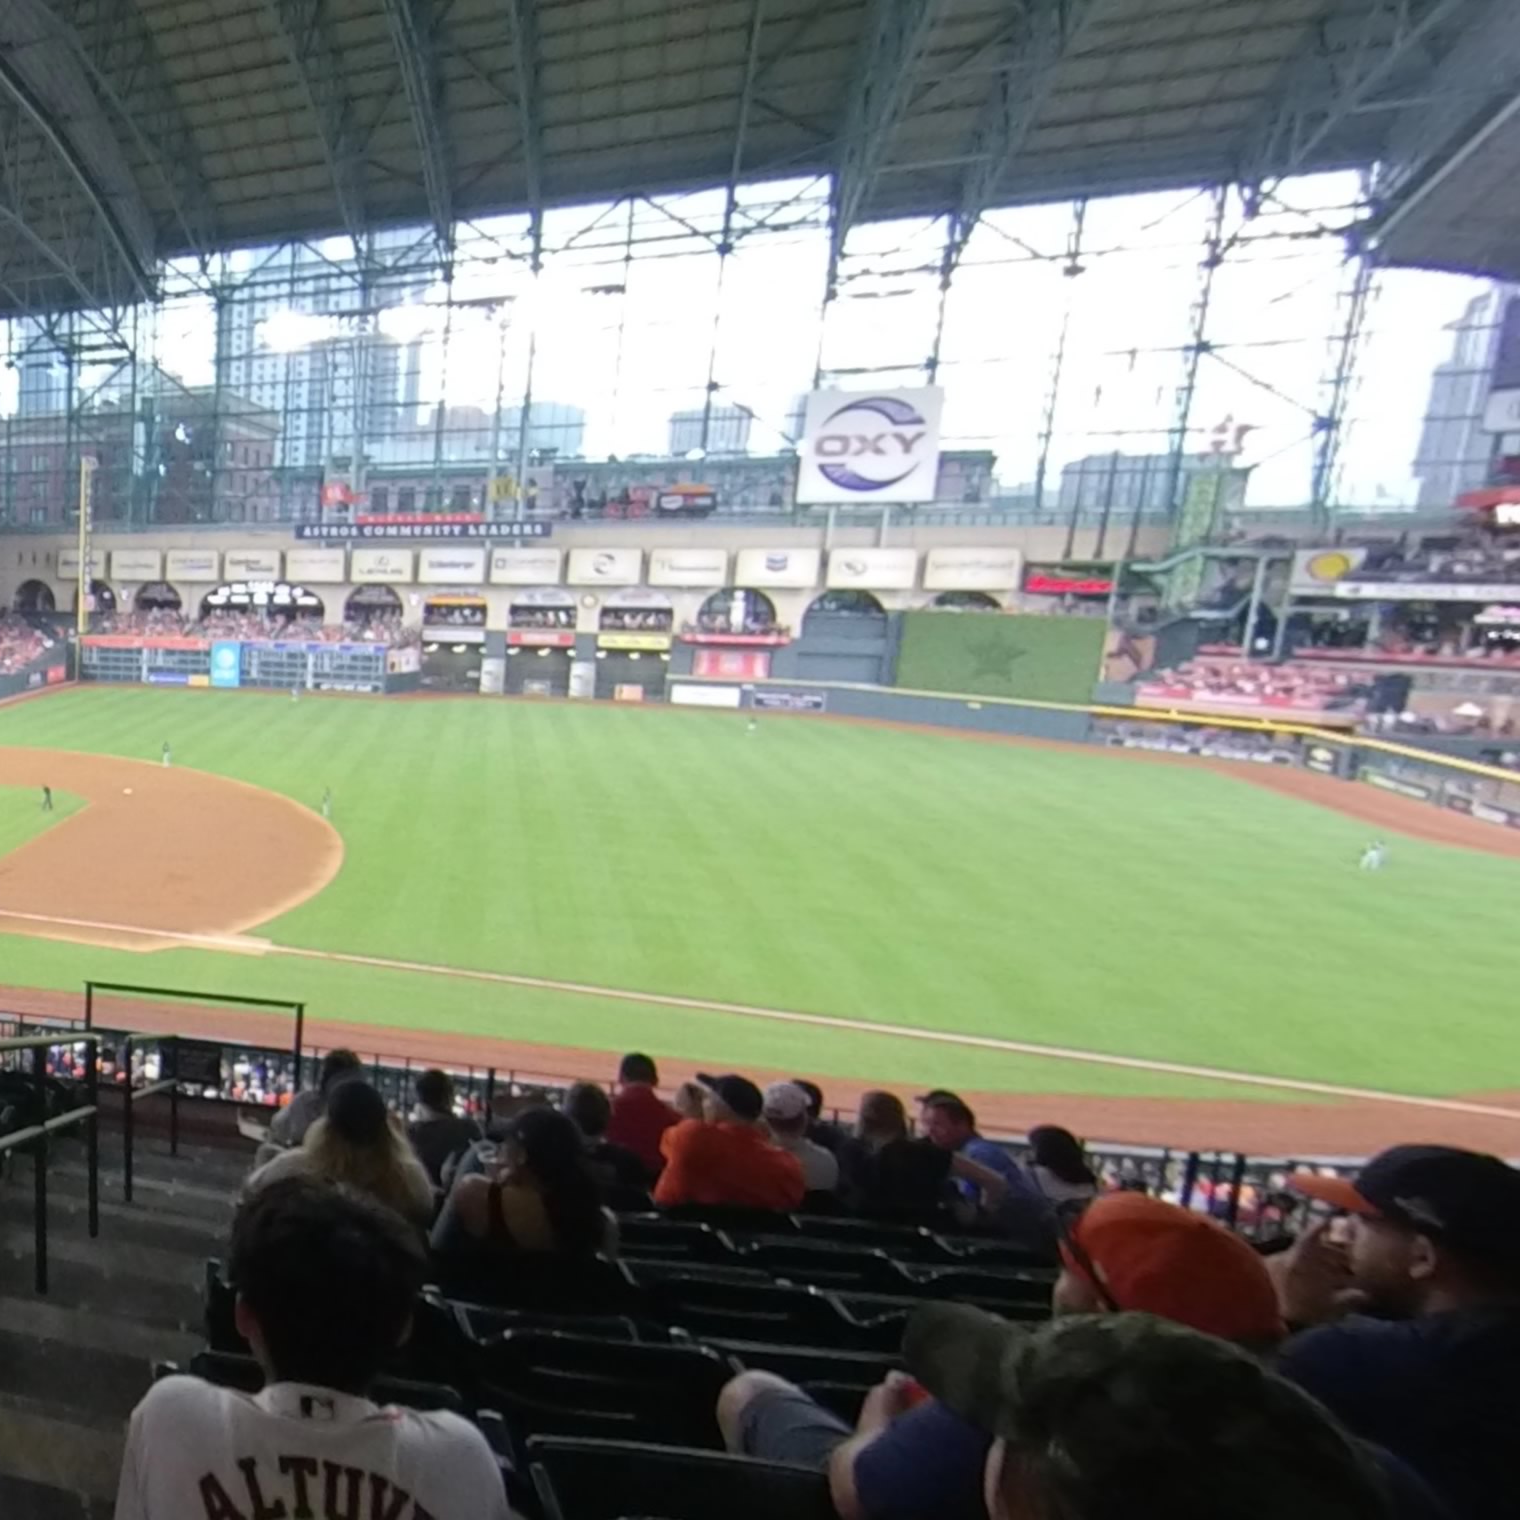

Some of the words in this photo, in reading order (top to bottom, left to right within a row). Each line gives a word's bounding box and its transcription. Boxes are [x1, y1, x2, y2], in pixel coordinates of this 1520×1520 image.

[814, 431, 926, 457] OXY
[302, 525, 358, 537] ASTROS
[363, 525, 462, 537] COMMUNITY
[468, 524, 543, 536] LEADERS
